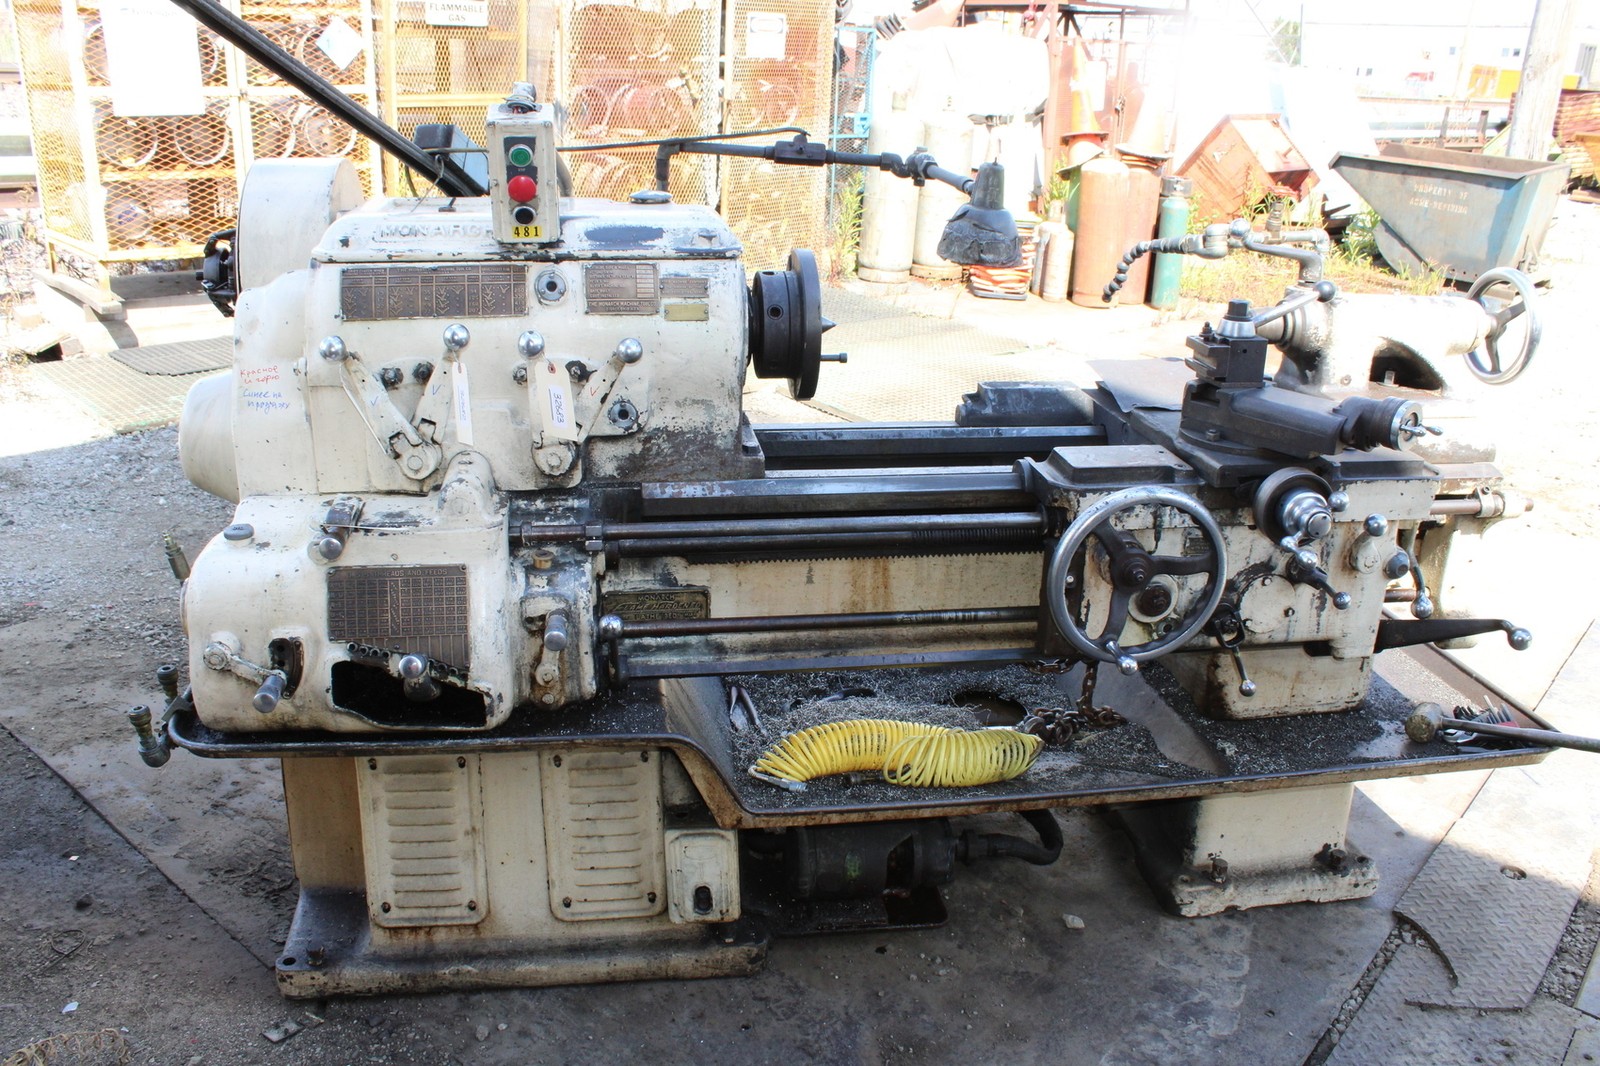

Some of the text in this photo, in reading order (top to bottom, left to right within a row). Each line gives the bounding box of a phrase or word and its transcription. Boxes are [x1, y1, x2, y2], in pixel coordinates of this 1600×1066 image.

[429, 3, 484, 13] FLAMMABLE
[448, 14, 466, 22] GAS
[513, 226, 540, 238] 481
[407, 569, 422, 577] AND
[425, 568, 448, 576] FEEDS
